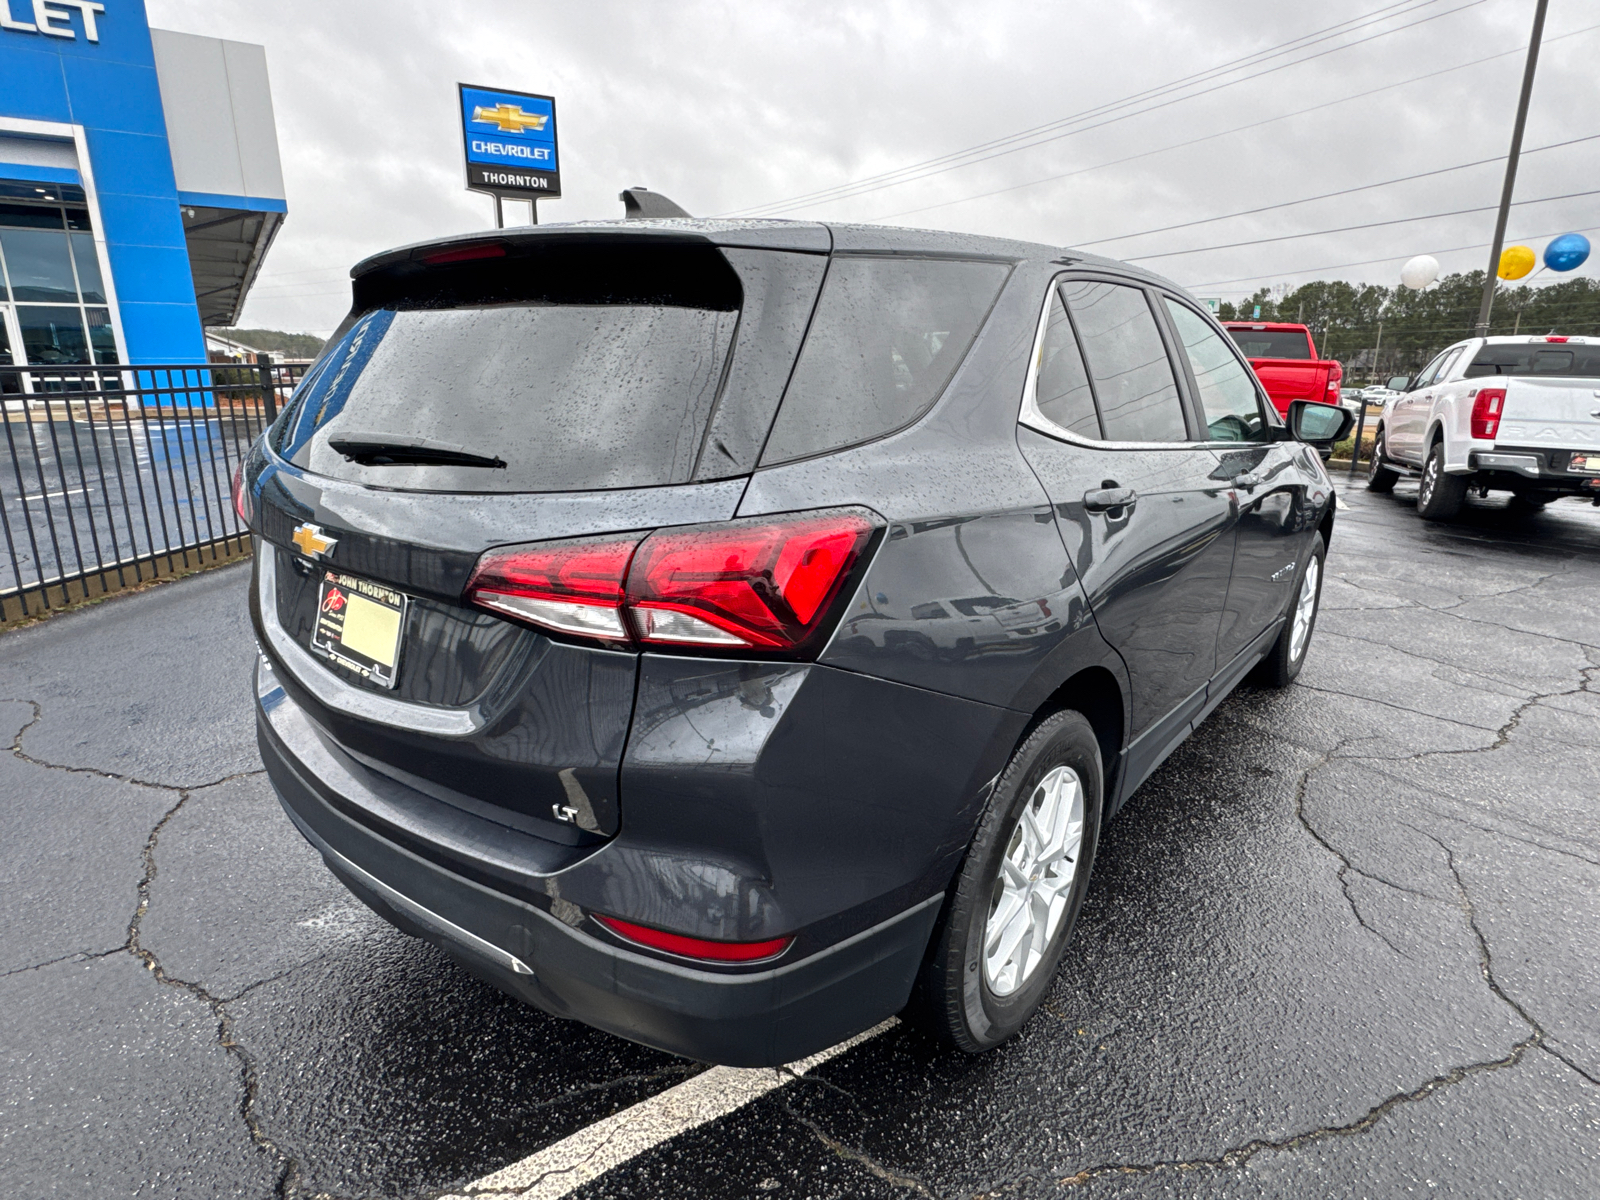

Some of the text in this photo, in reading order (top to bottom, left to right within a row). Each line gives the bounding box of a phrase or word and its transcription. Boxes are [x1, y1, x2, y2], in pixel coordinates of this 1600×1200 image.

[472, 140, 551, 160] CHEVROLET
[482, 171, 548, 188] THORNTON
[338, 574, 401, 606] JOHN THORNTON
[552, 803, 579, 823] LT
